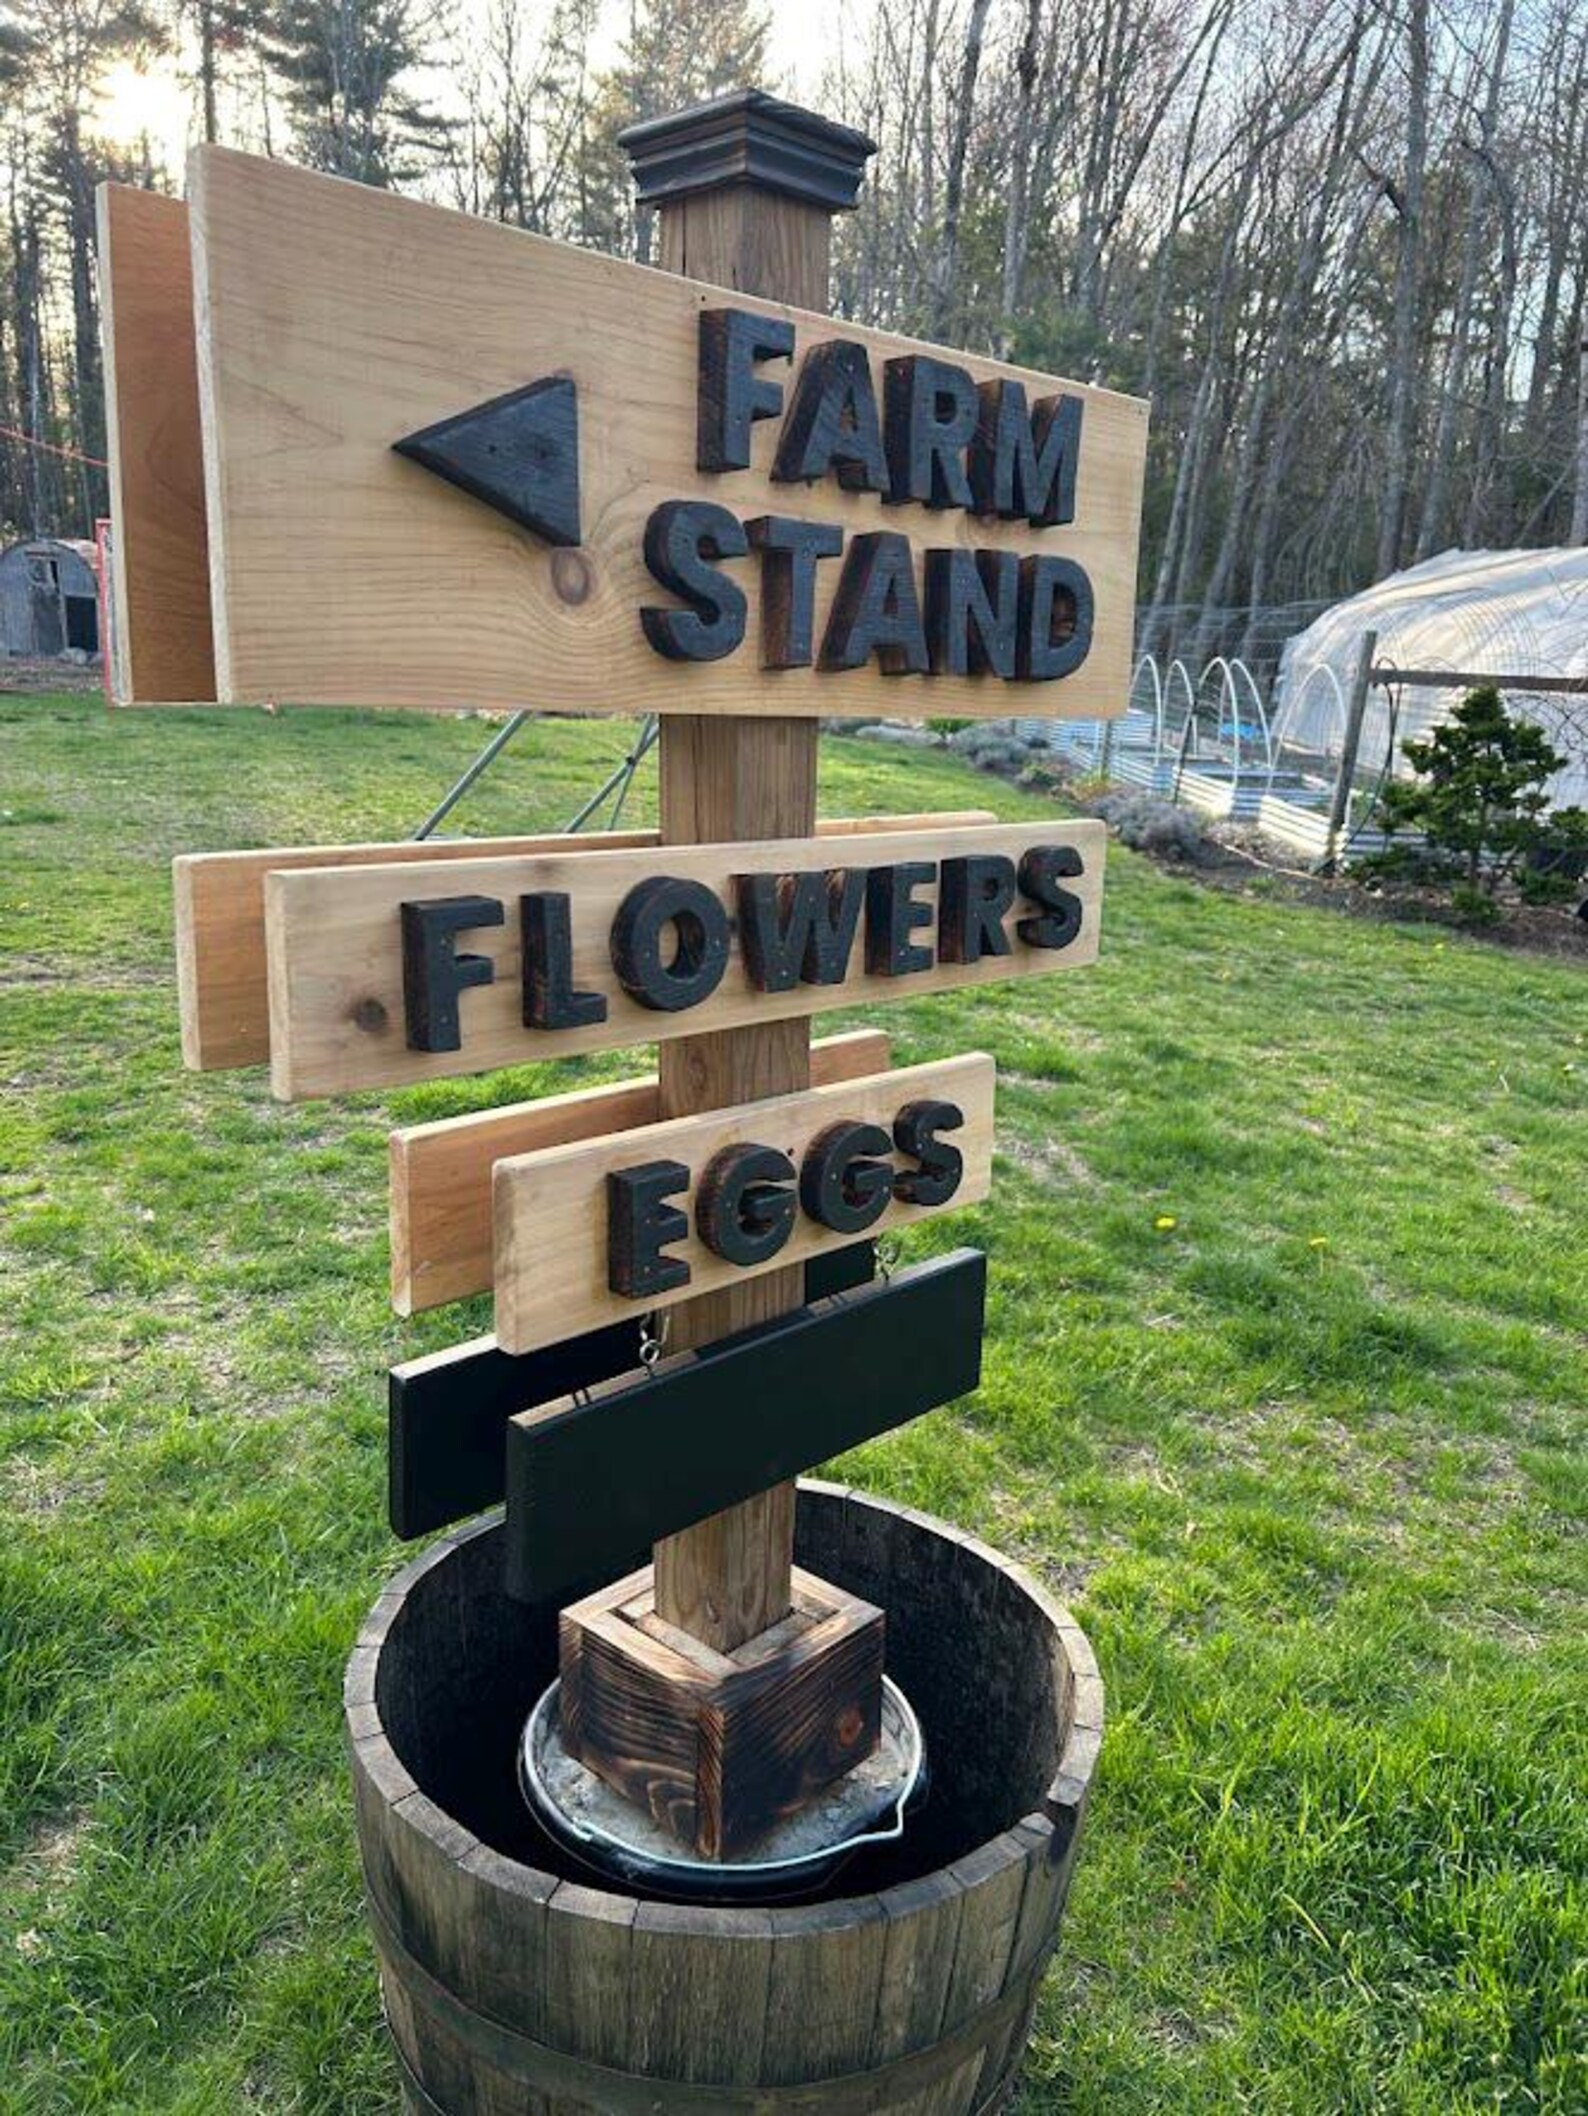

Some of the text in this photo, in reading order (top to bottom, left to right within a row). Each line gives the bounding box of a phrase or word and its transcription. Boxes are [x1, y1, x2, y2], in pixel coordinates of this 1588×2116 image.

[696, 308, 1084, 525] FARM
[641, 500, 1094, 680] STAND
[402, 845, 1084, 1052] FLOWERS
[608, 1100, 965, 1298] EGGS
